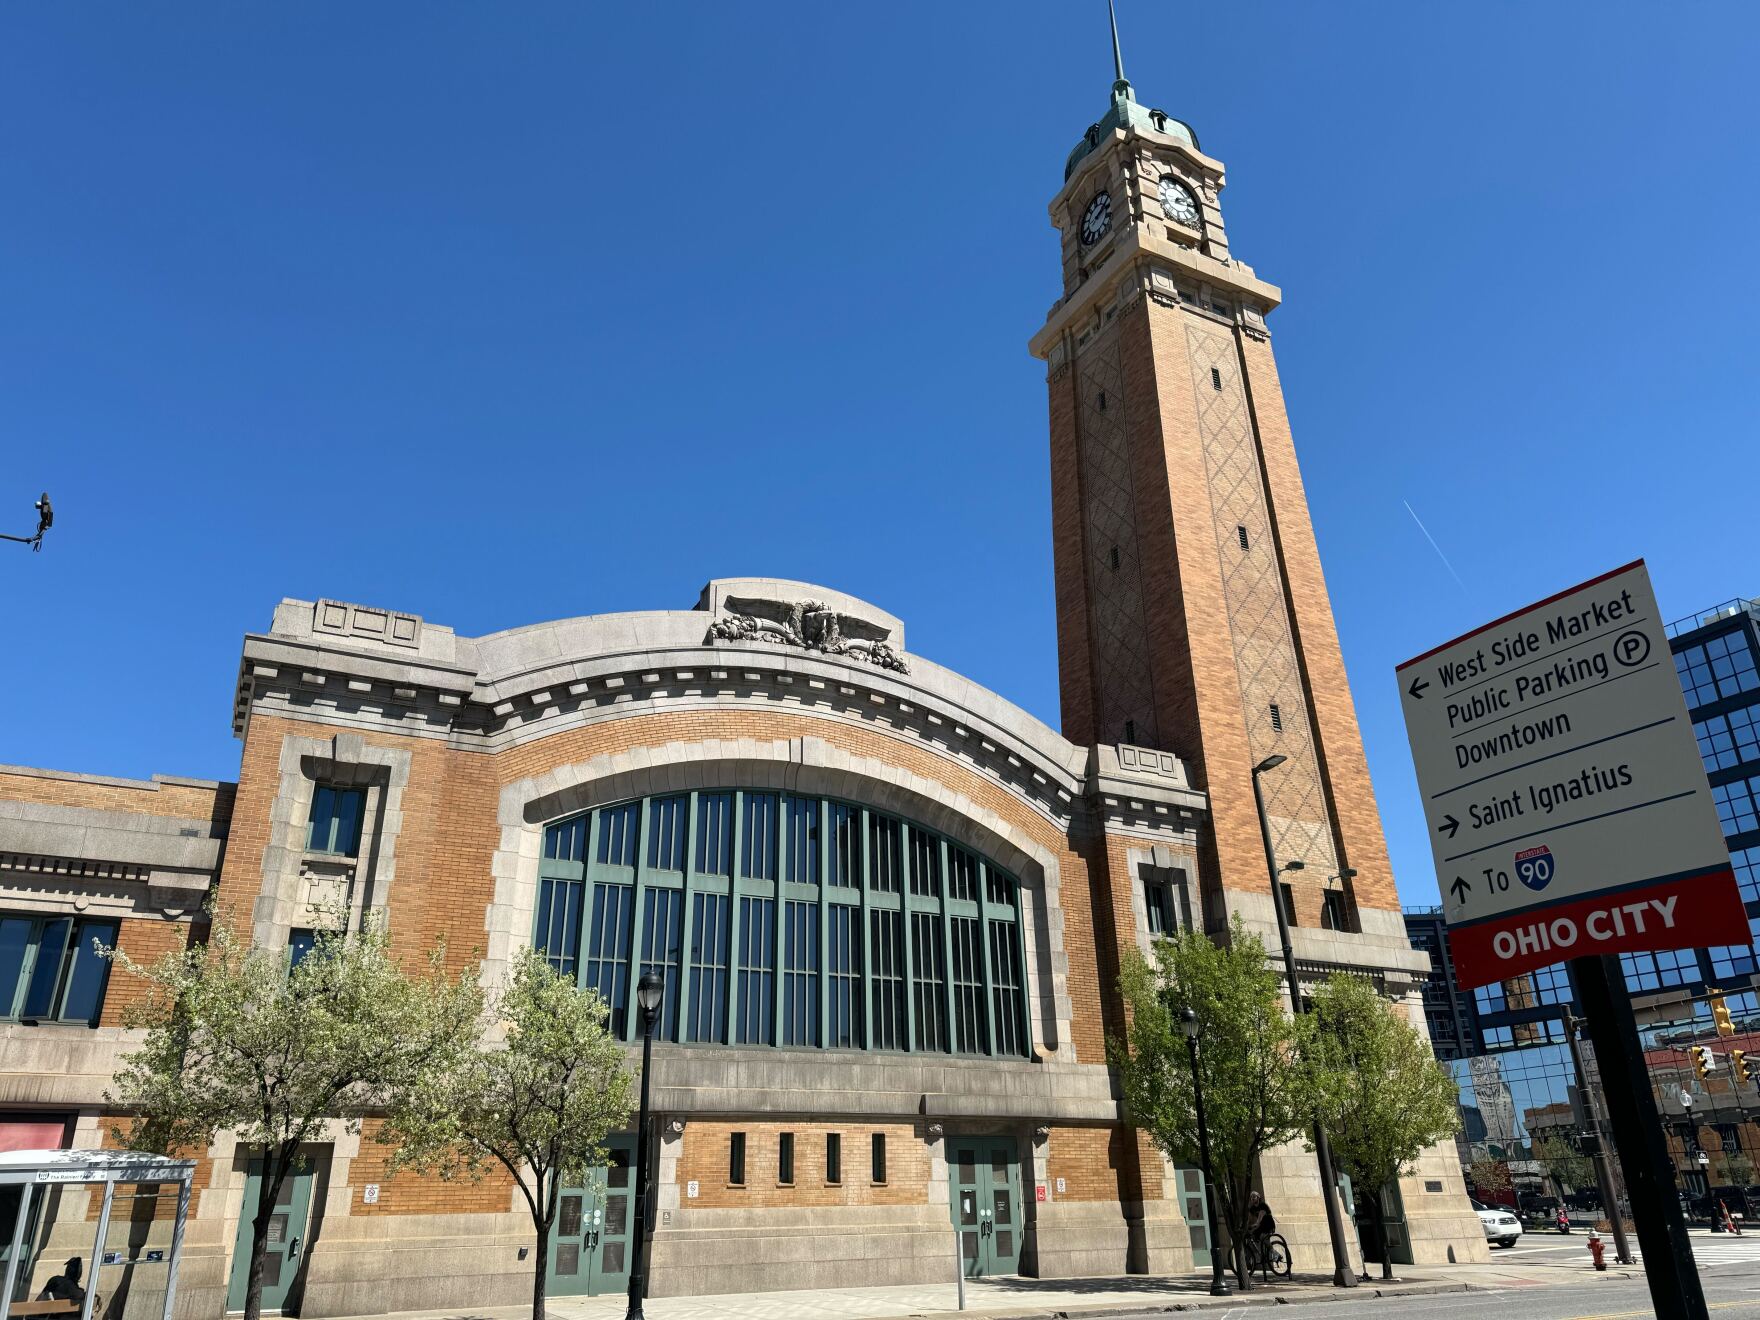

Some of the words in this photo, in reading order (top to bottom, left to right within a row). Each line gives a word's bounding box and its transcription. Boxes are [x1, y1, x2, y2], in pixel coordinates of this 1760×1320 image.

[1438, 650, 1487, 688] West
[1491, 632, 1540, 666] Side
[1545, 589, 1635, 644] Market
[1447, 687, 1510, 728] Public
[1515, 653, 1609, 702] Parking
[1622, 638, 1640, 660] P
[1455, 712, 1571, 769] Downtown
[1469, 790, 1523, 829] Saint
[1528, 765, 1633, 813] Ignatius
[1483, 868, 1509, 894] To
[1521, 859, 1549, 883] 90
[1518, 847, 1547, 859] INTERSTATE
[1493, 917, 1577, 959] OHIO
[1586, 895, 1678, 941] CITY
